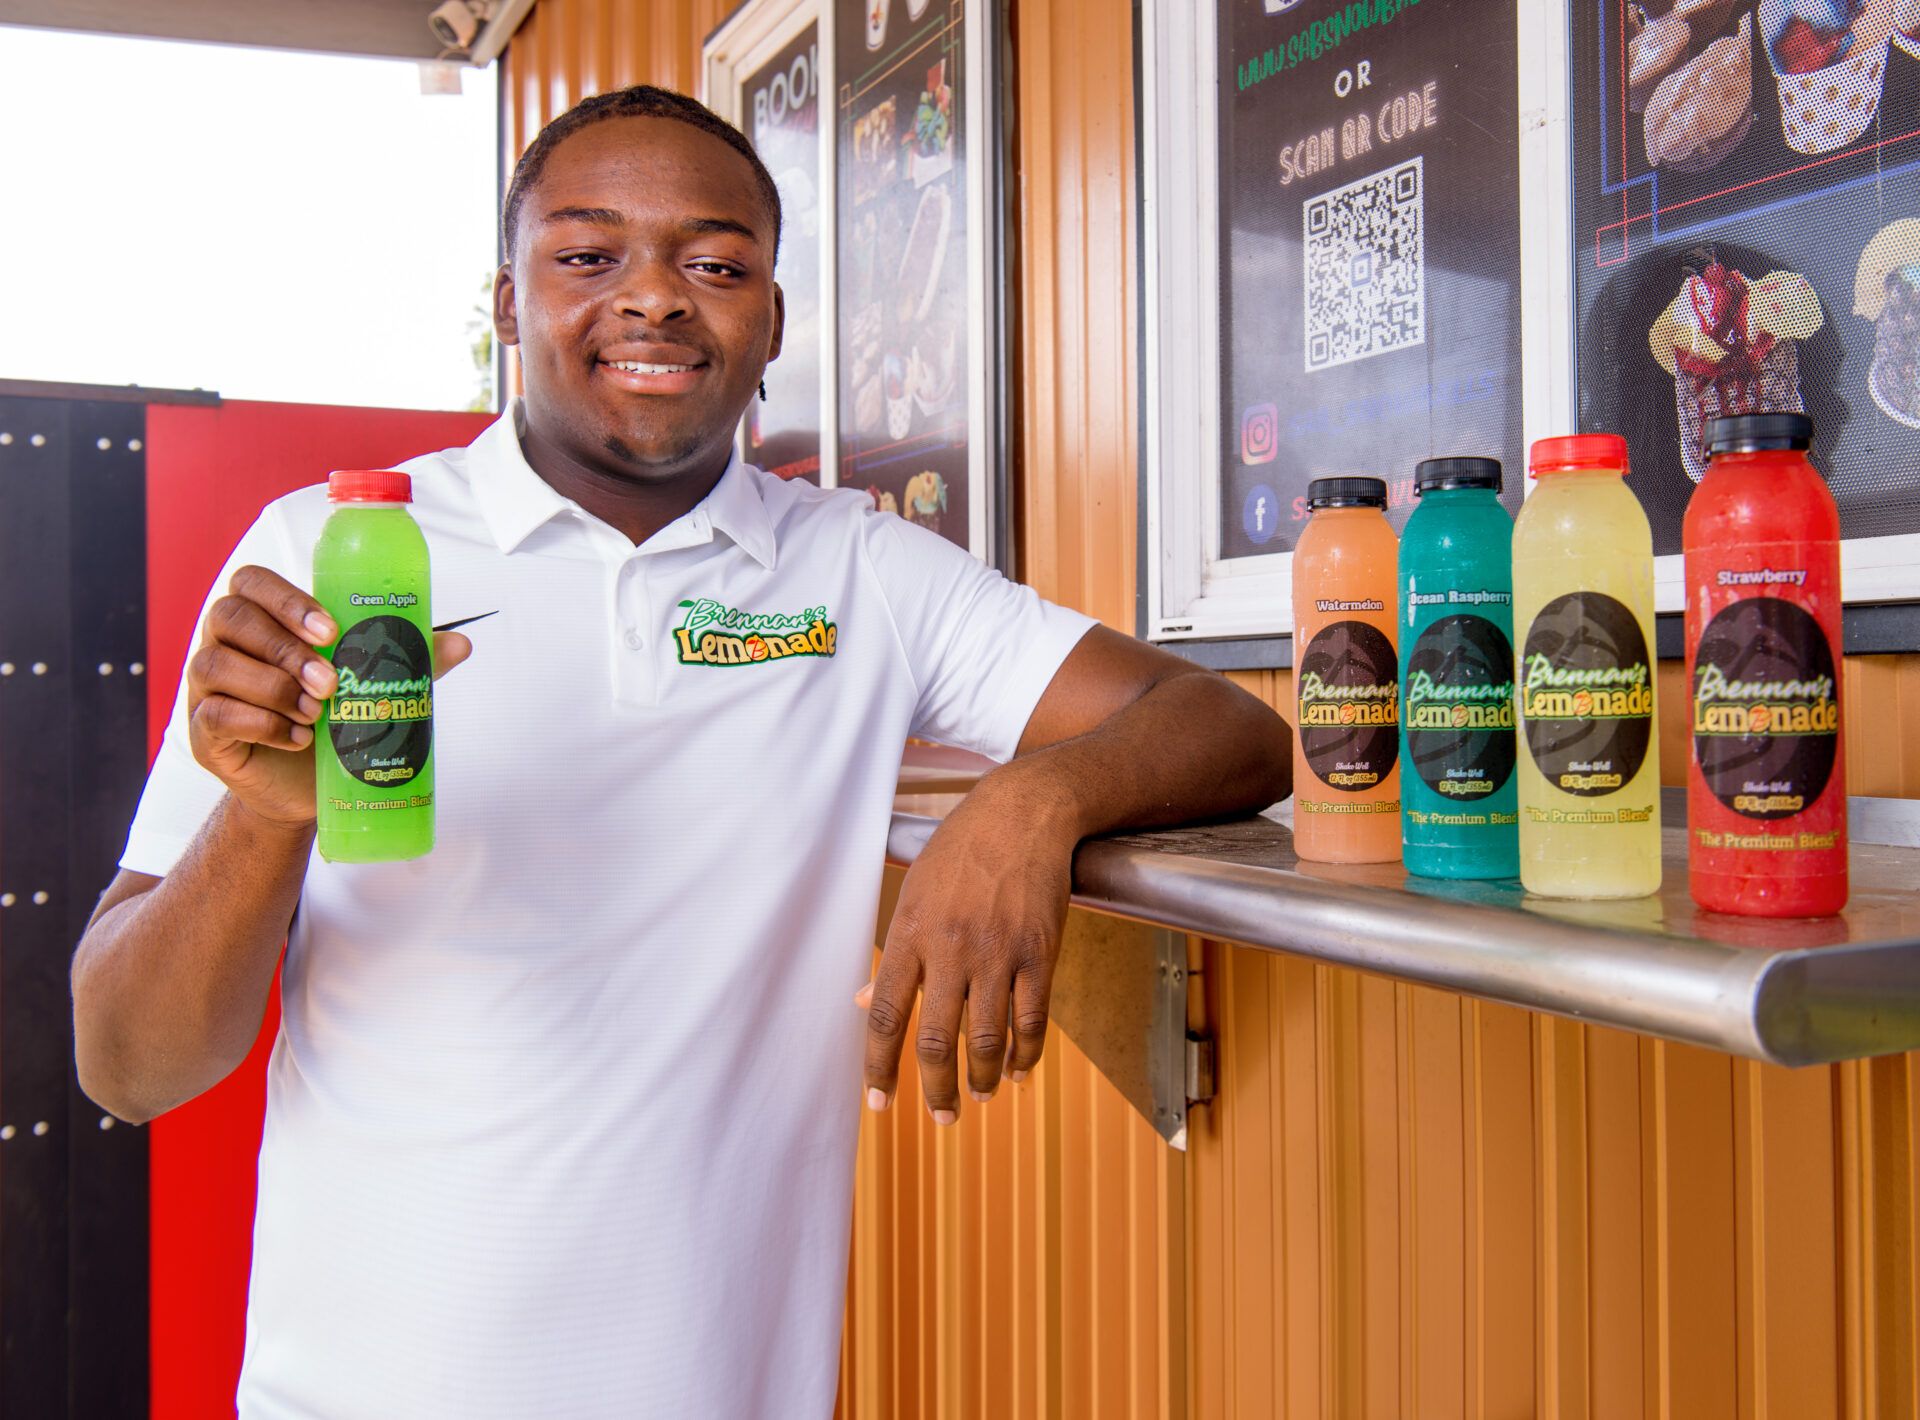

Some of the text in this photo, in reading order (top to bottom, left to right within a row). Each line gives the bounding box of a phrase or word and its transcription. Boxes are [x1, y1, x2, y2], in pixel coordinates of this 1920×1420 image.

[1334, 60, 1372, 98] OR
[1279, 81, 1438, 186] SCAN QR CODE
[1717, 569, 1807, 585] Strawberry
[350, 593, 417, 608] Green Apple
[1317, 600, 1383, 611] Watermelon
[1410, 590, 1511, 606] Ocean Raspberry
[684, 599, 827, 630] Brennan's
[674, 621, 838, 666] Lemonade
[1527, 652, 1648, 688] Brennan's
[336, 666, 431, 696] Brennan's
[1303, 671, 1398, 701] Brennan's
[1698, 662, 1833, 701] Brennan's
[1523, 682, 1652, 717] Lemonade
[1694, 695, 1838, 733] Lemonade
[371, 757, 405, 767] Shake Well
[1336, 762, 1369, 770] Shake Well
[1447, 768, 1484, 777] Shake Well
[356, 799, 407, 810] Premium
[1322, 802, 1372, 813] Premium
[1550, 804, 1615, 823] Premium
[1431, 812, 1486, 825] Premium
[1723, 832, 1796, 849] Premium
